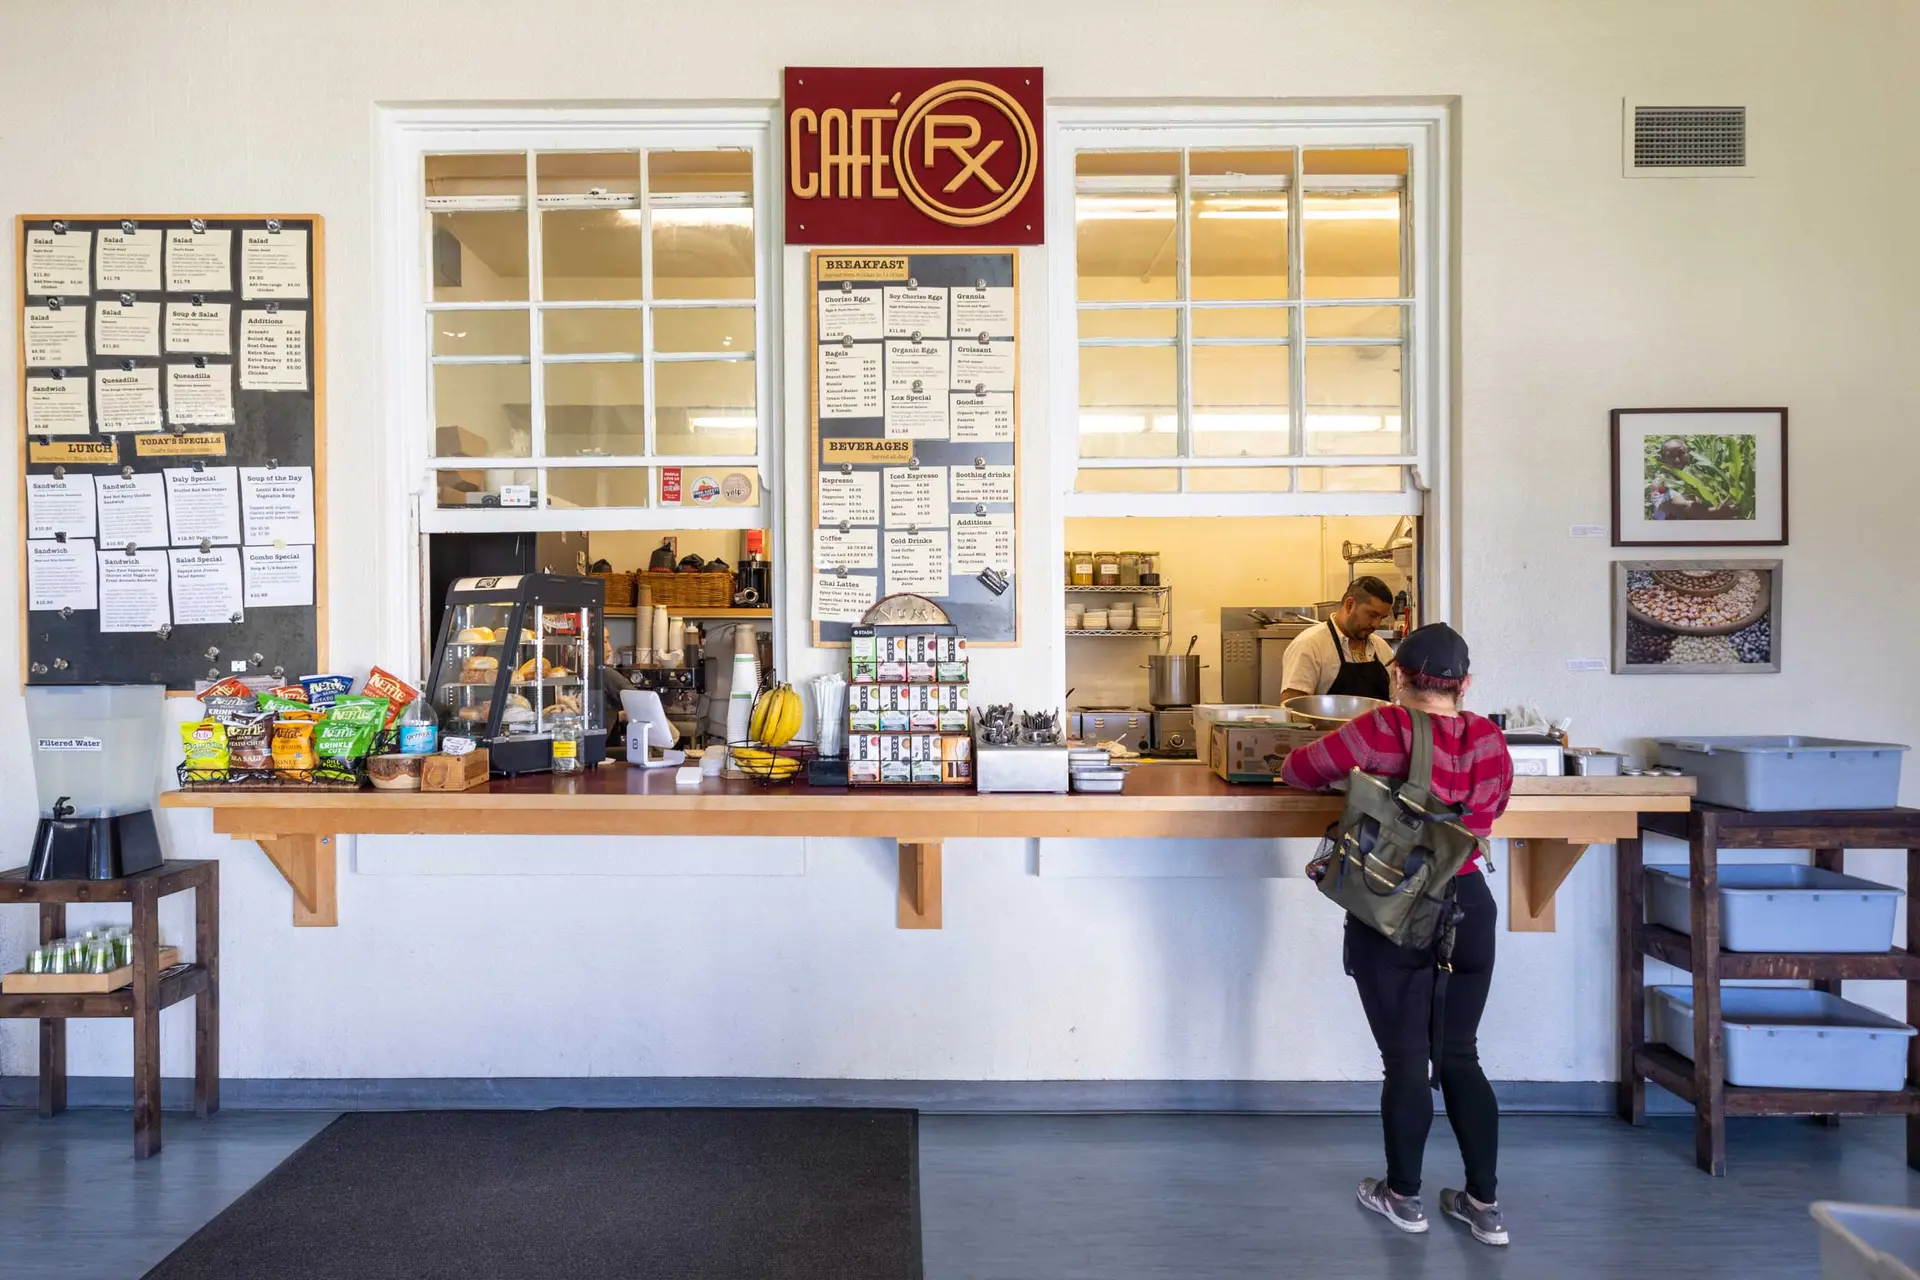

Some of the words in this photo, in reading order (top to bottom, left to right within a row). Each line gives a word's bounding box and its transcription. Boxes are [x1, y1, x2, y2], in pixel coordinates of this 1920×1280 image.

[790, 91, 902, 199] CAFÉ
[826, 259, 905, 270] BREAKFAST
[853, 296, 871, 304] Eggs
[172, 310, 189, 318] Soup
[101, 376, 139, 385] Quesadilla
[905, 394, 932, 402] Special
[140, 438, 177, 446] TODAY'S
[829, 441, 909, 451] BEVERAGES
[68, 443, 113, 453] LUNCH
[172, 475, 189, 483] Daly
[190, 475, 217, 483] Special
[955, 471, 987, 479] Soothing
[725, 488, 742, 497] yelp
[197, 556, 223, 564] Special
[836, 580, 860, 588] Lattes
[367, 671, 406, 703] KETTLE
[39, 739, 73, 747] Filtered
[75, 739, 101, 747] Water
